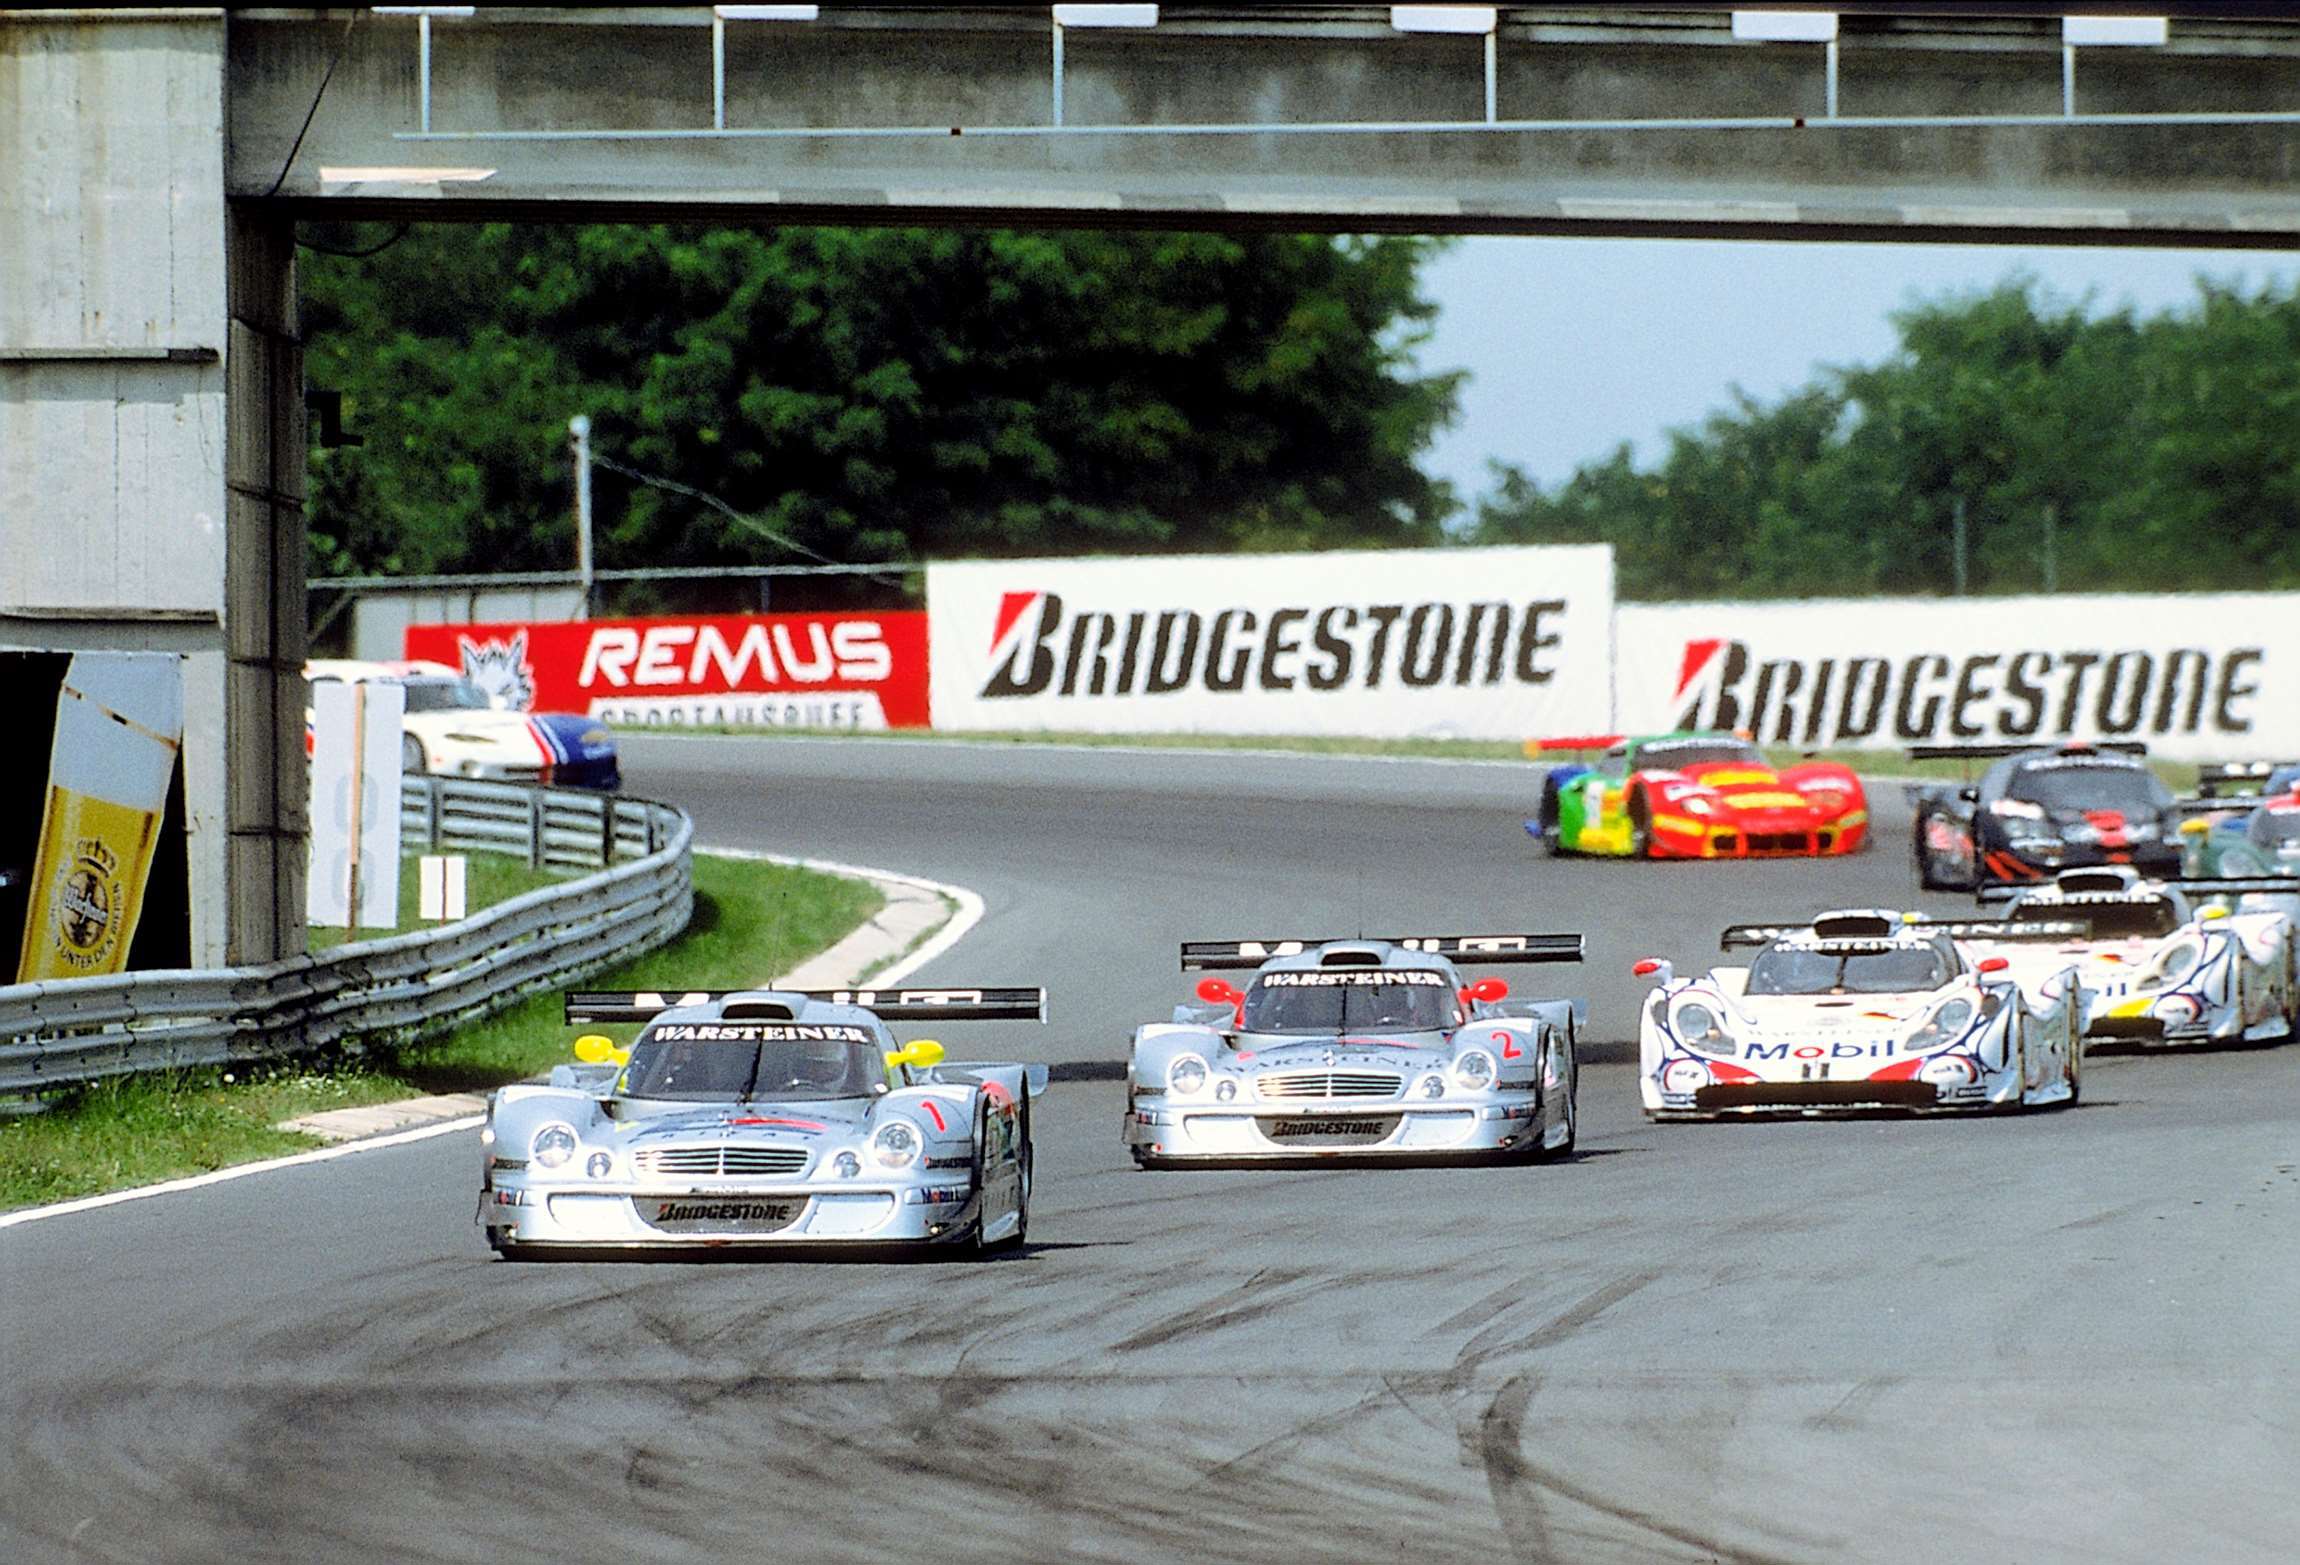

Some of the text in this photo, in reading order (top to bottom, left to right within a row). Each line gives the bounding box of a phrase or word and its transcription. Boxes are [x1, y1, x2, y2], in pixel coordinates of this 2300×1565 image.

[578, 621, 893, 688] REMUS
[977, 591, 1567, 699] BRIDGESTONE
[1672, 639, 2264, 744] BRIDGESTONE
[1263, 971, 1445, 988] WARSTEINER
[653, 1025, 869, 1044] WARSTEINER
[1490, 1031, 1522, 1060] 2
[1743, 1039, 1894, 1060] Mobil
[921, 1101, 946, 1132] 1
[1271, 1120, 1384, 1137] BRIDGESTONE
[656, 1202, 790, 1222] BRIDGESTONE
